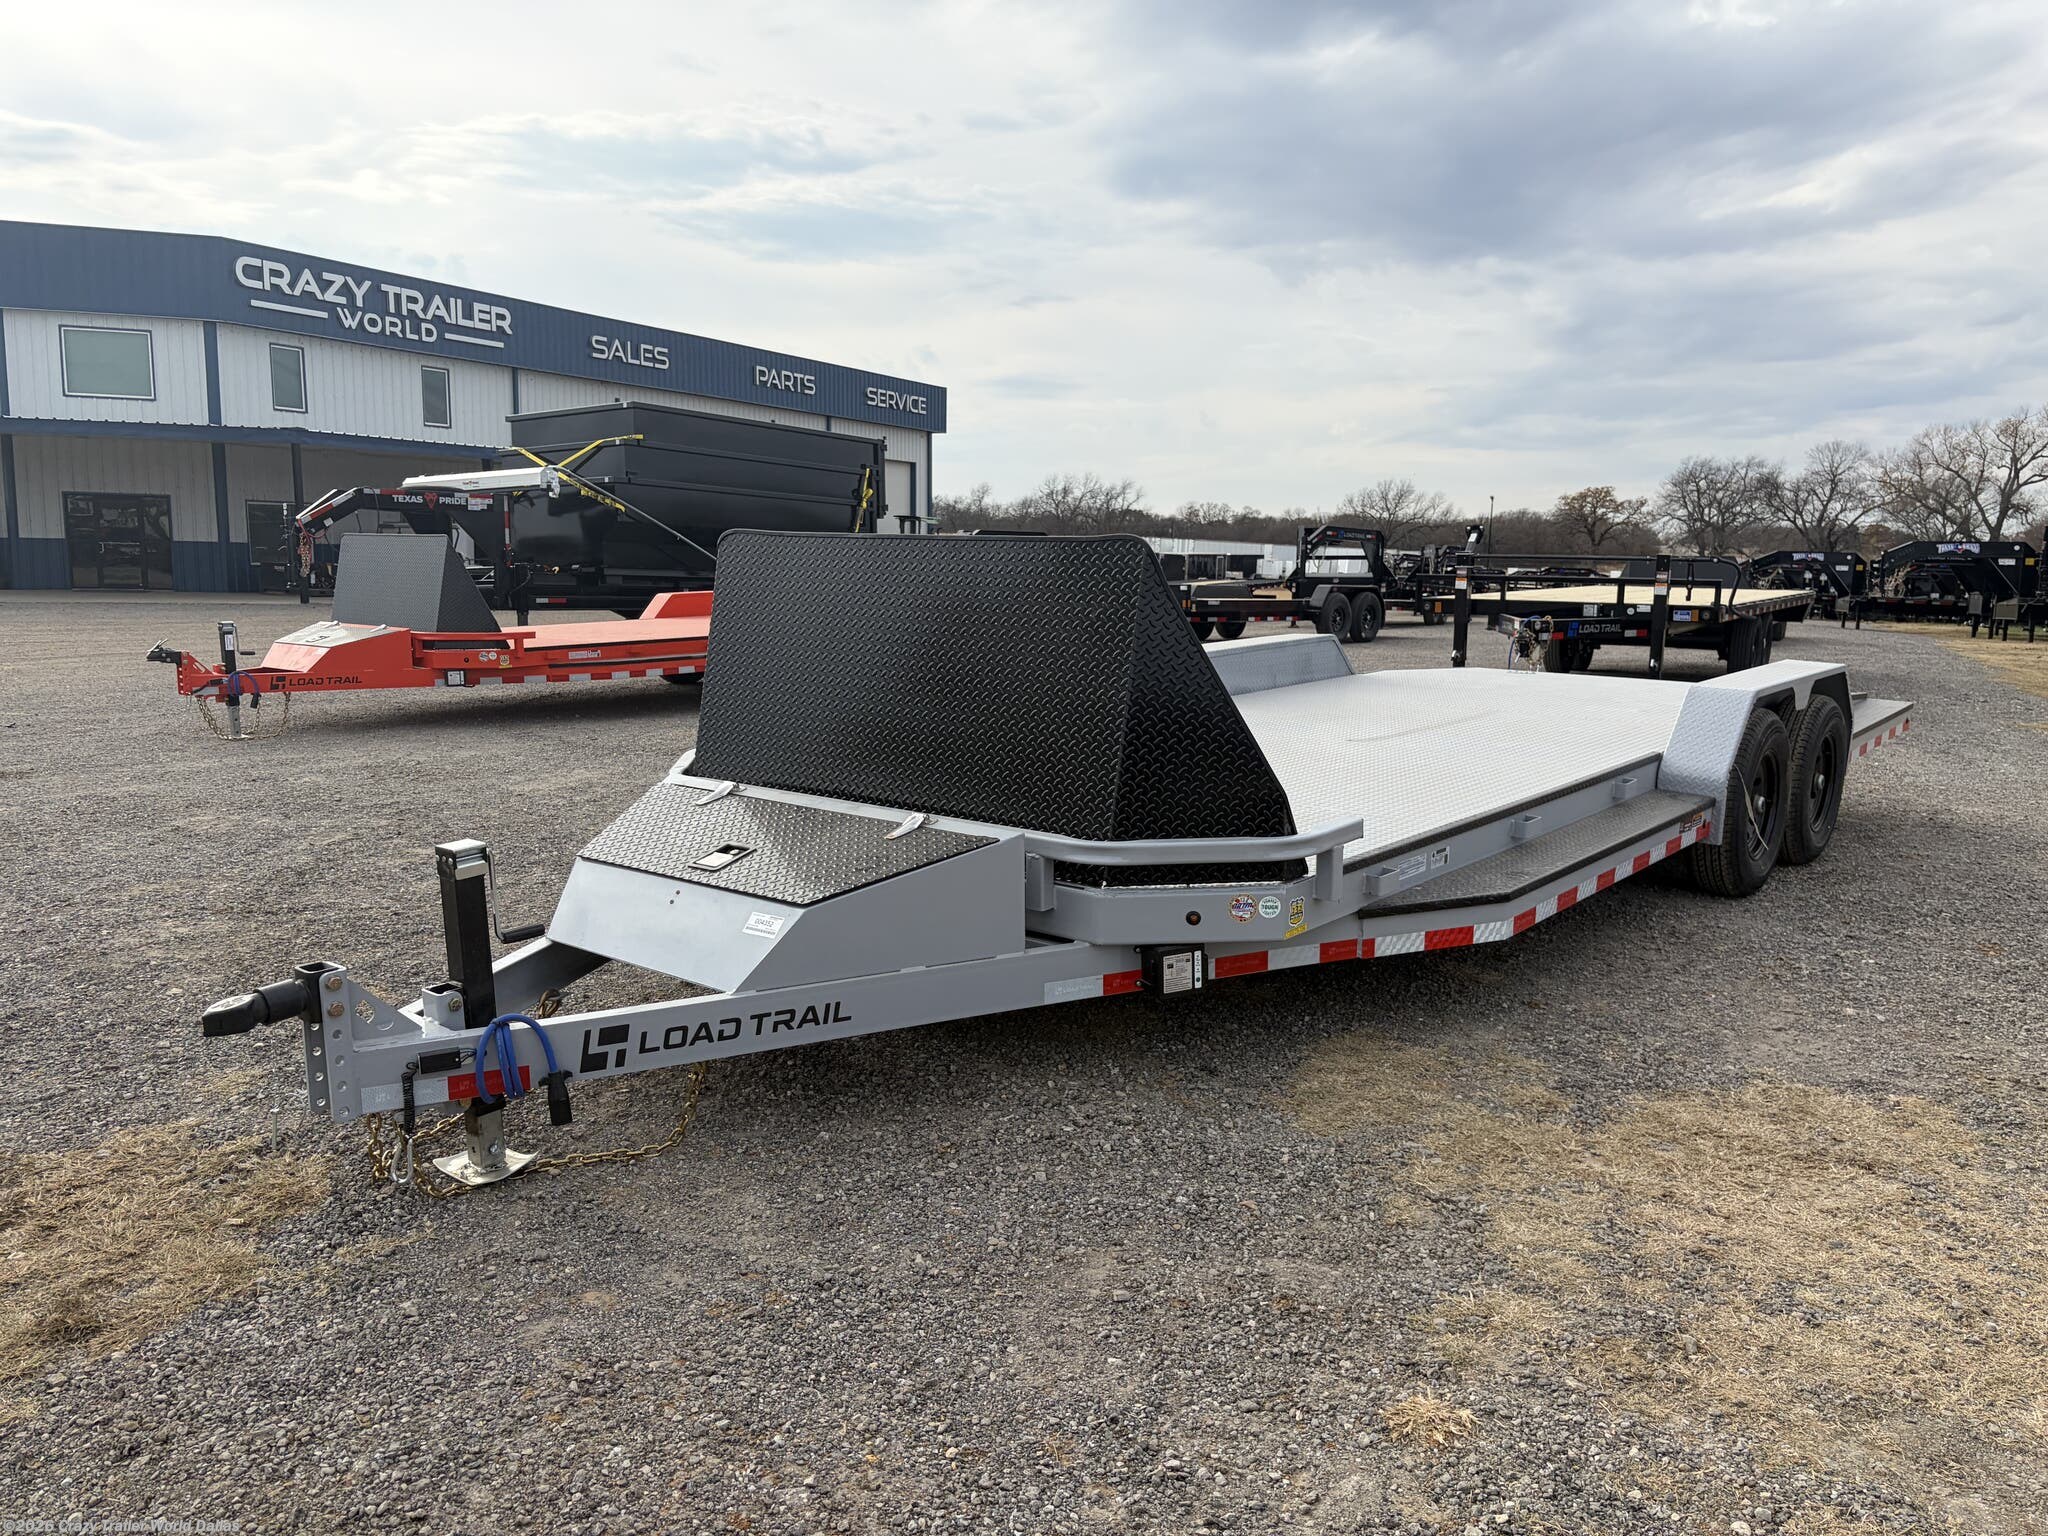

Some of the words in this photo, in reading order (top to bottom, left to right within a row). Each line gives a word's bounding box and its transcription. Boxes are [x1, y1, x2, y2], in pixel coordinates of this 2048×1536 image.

[235, 256, 371, 307] CRAZY
[381, 284, 513, 335] TRAILER
[336, 307, 438, 343] WORLD
[591, 335, 669, 369] SALES
[756, 365, 816, 395] PARTS
[866, 387, 927, 415] SERVICE
[392, 494, 423, 503] TEXAS
[439, 496, 467, 505] PRIDE
[1579, 624, 1600, 633] LOAD
[1601, 623, 1622, 632] TRAIL
[289, 678, 324, 687] LOAD
[326, 675, 362, 685] TRAIL
[639, 1017, 742, 1054] LOAD
[750, 1001, 852, 1036] TRAIL
